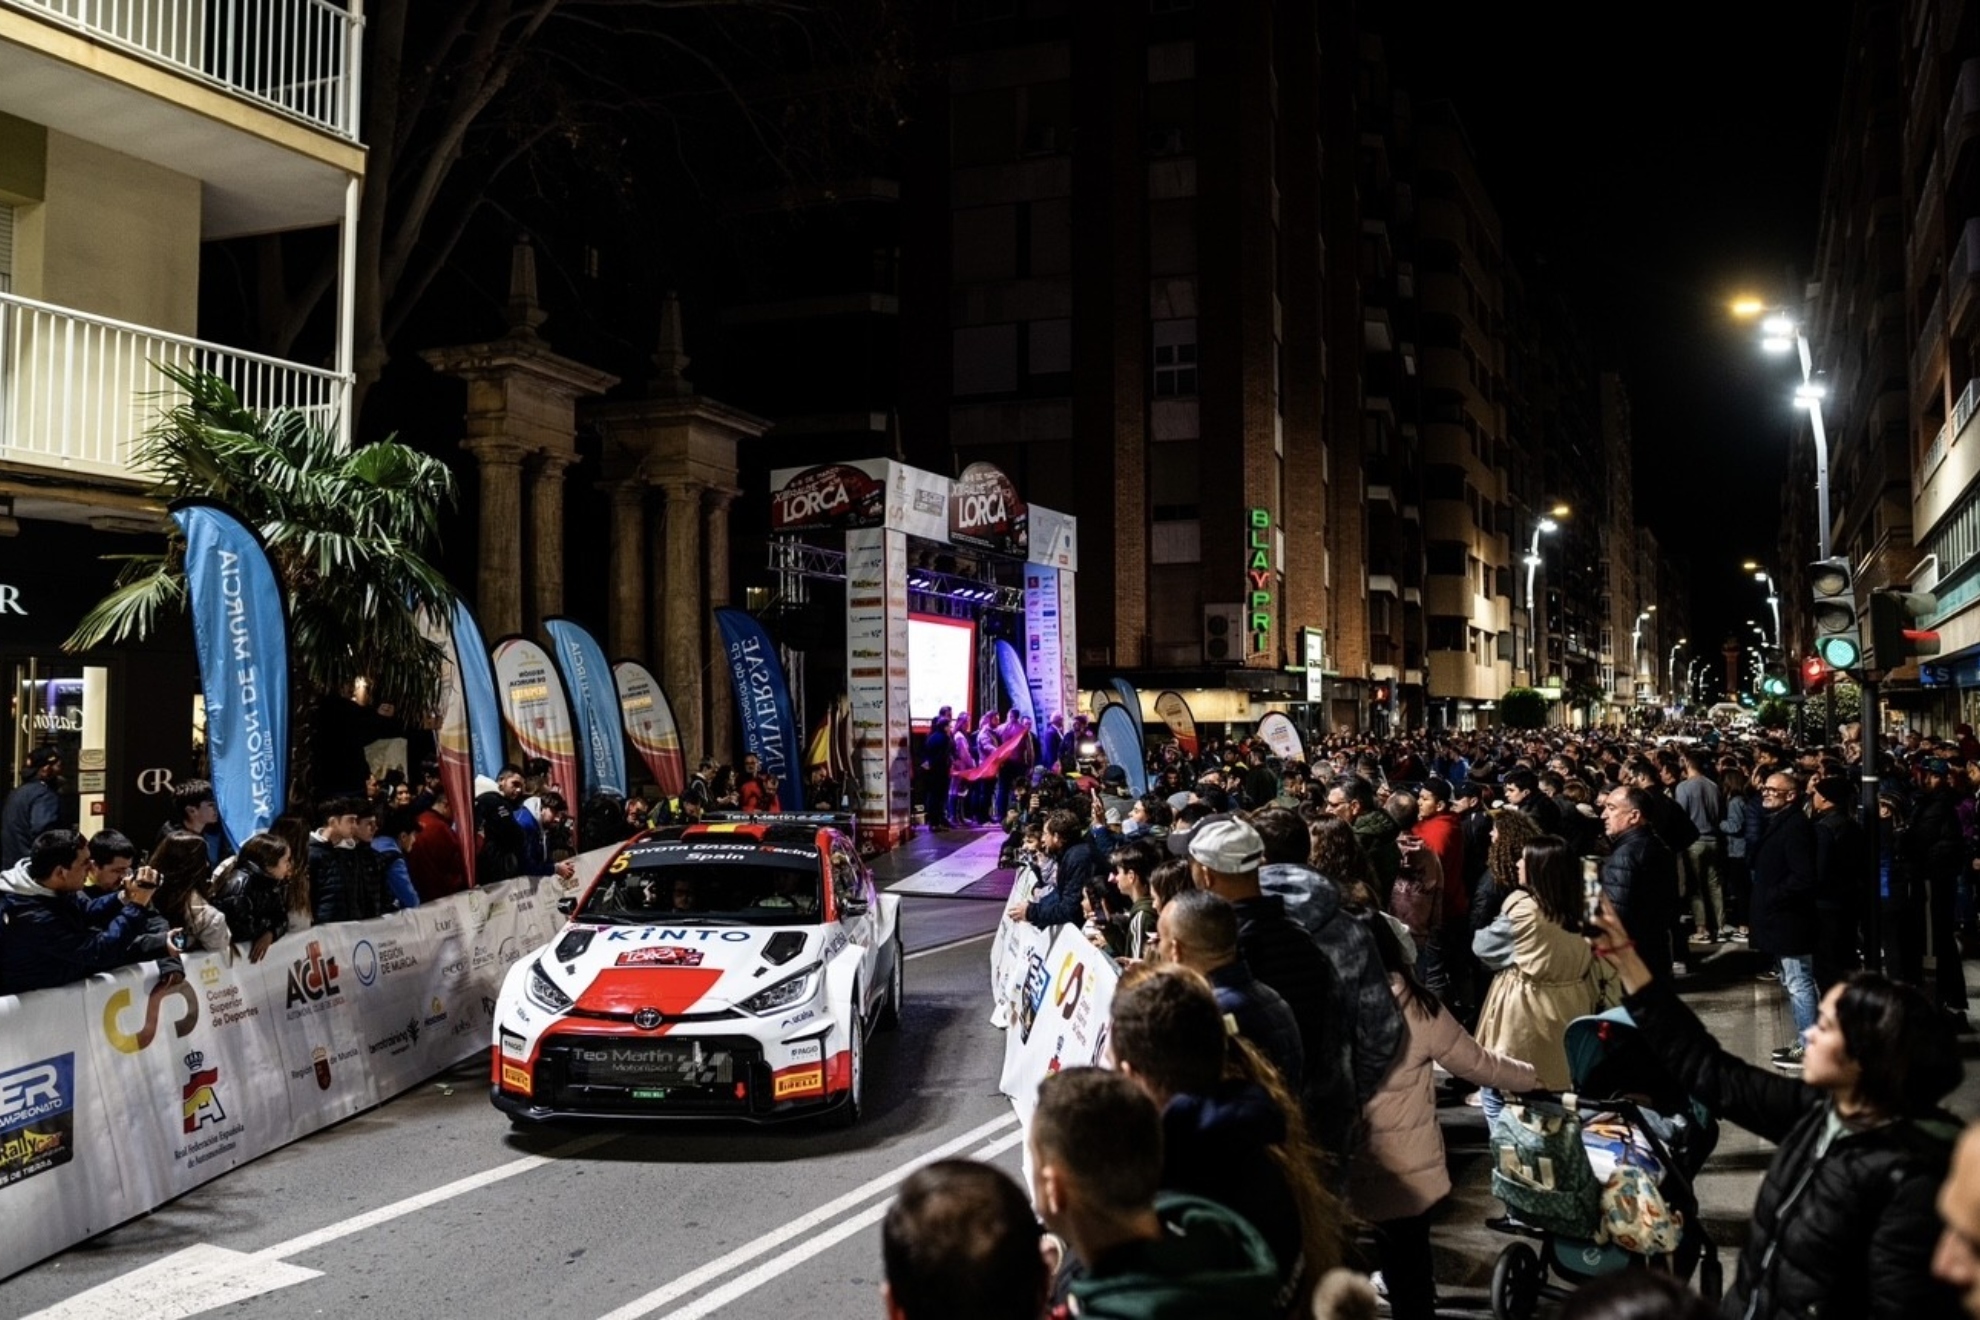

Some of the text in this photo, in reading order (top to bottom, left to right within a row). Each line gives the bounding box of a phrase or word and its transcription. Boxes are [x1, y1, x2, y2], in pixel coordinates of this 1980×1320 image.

[783, 483, 850, 523] LORCA
[959, 493, 1007, 528] LORCA
[1252, 509, 1271, 653] BLAYPRI
[0, 584, 28, 615] R
[623, 843, 819, 858] TOYOTA GAZOO Racing
[684, 852, 745, 862] Spain
[609, 853, 631, 874] 5
[206, 986, 240, 1002] Consejo
[209, 998, 243, 1016] Superior
[212, 1006, 259, 1028] de Deportes
[574, 1049, 608, 1061] Teo
[612, 1062, 673, 1072] Motorsport
[778, 1075, 819, 1093] PIRELLI
